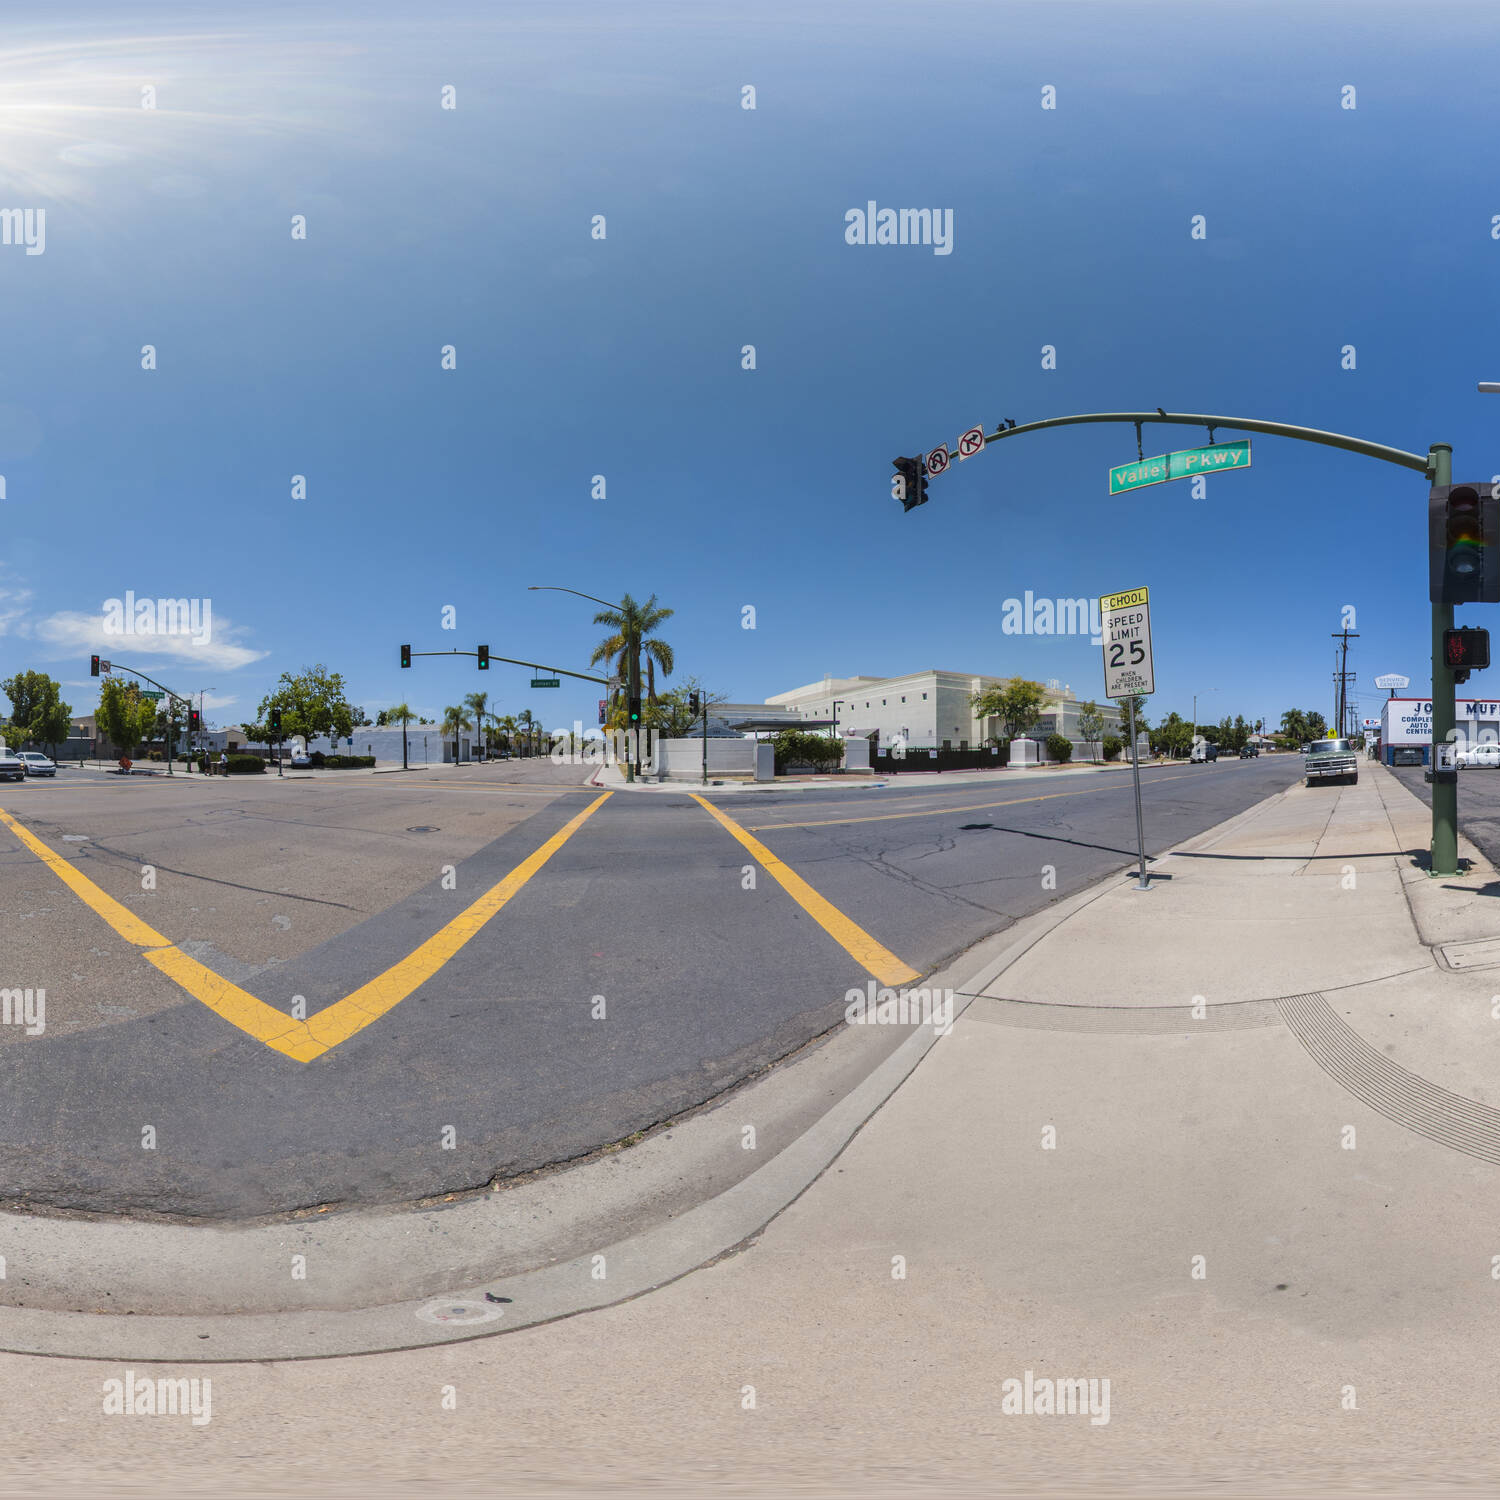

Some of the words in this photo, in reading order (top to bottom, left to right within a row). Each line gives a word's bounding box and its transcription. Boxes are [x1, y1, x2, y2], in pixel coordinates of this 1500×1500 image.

[1116, 462, 1171, 486] Valley
[1185, 448, 1243, 470] Pkwy
[1103, 592, 1144, 609] SCHOOL
[1107, 613, 1143, 629] SPEED
[1111, 627, 1140, 641] LIMIT
[1109, 640, 1145, 668] 25
[1116, 675, 1142, 684] CHILDREN
[1124, 680, 1148, 688] PRESENT
[1414, 703, 1432, 713] JO
